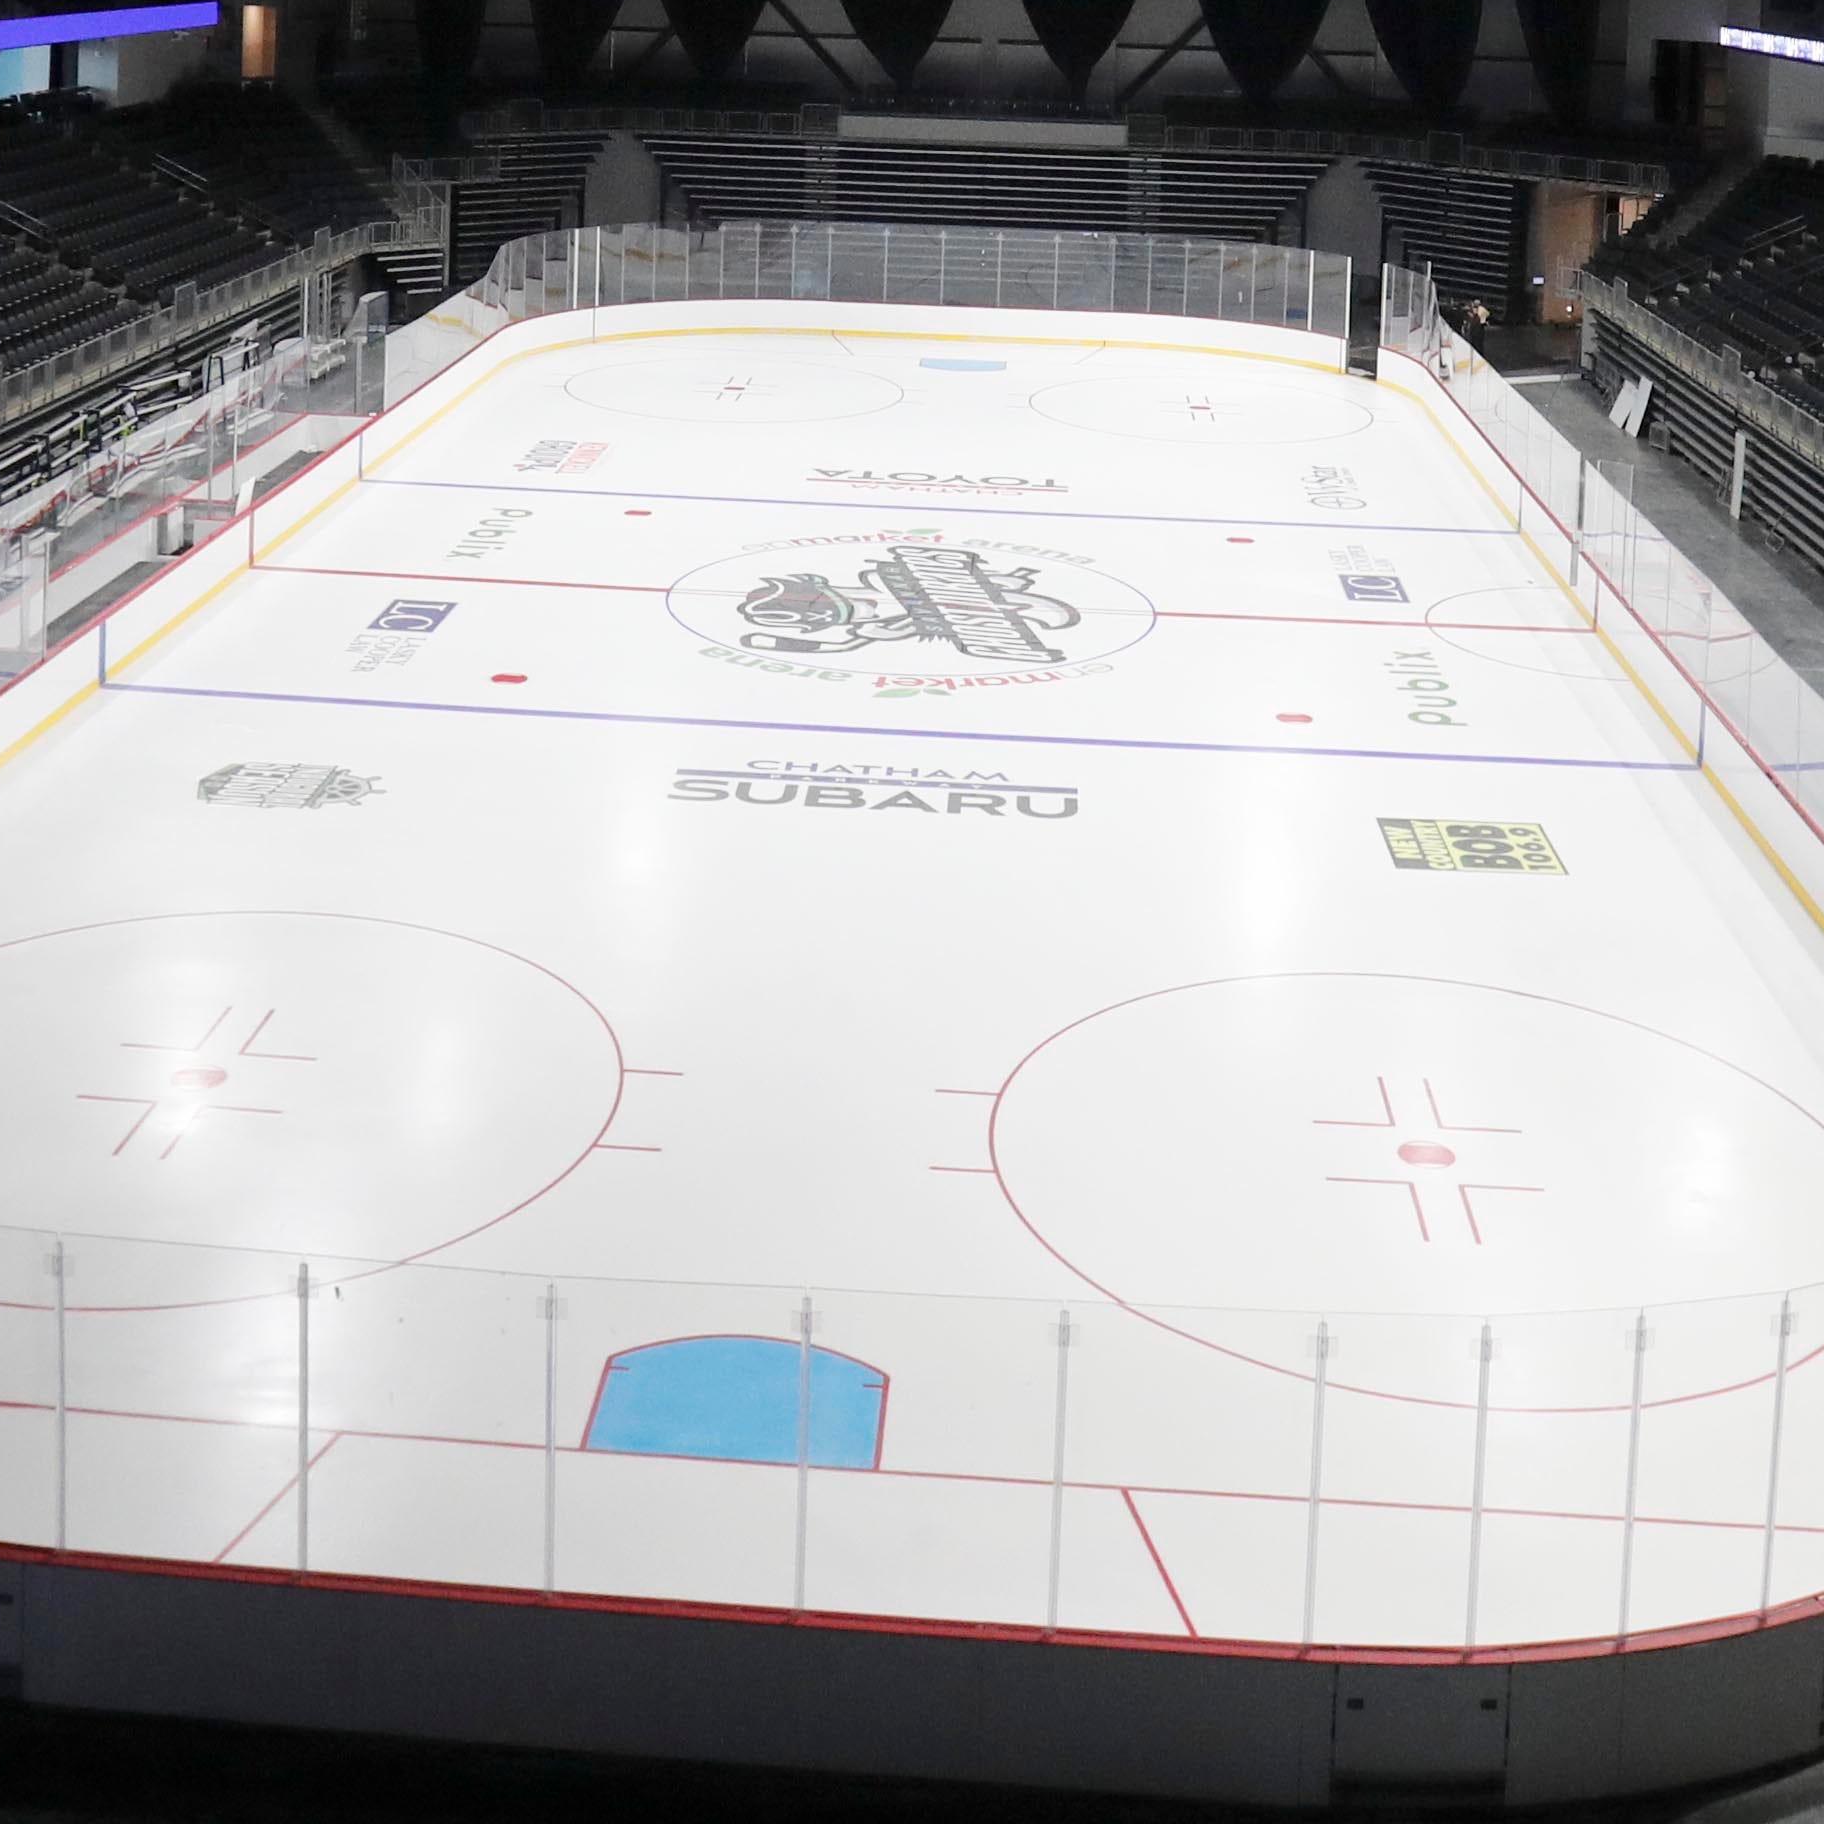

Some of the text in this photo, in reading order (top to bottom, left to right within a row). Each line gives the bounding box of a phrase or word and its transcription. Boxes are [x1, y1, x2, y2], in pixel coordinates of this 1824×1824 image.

[812, 468, 1069, 489] TOYOTA
[446, 507, 533, 560] publix
[741, 531, 1096, 565] enmarket arena
[1348, 577, 1402, 601] LC
[379, 602, 447, 629] LC
[386, 637, 426, 666] LASKY
[697, 644, 1115, 689] enmarket arena
[1383, 650, 1468, 726] publix
[746, 760, 1010, 782] CHATHAM
[666, 778, 1079, 820] SUBARU
[1384, 826, 1424, 860] NEW
[1411, 820, 1454, 870] COUNTRY
[1446, 824, 1525, 870] BOB
[1507, 826, 1558, 871] 106.9
